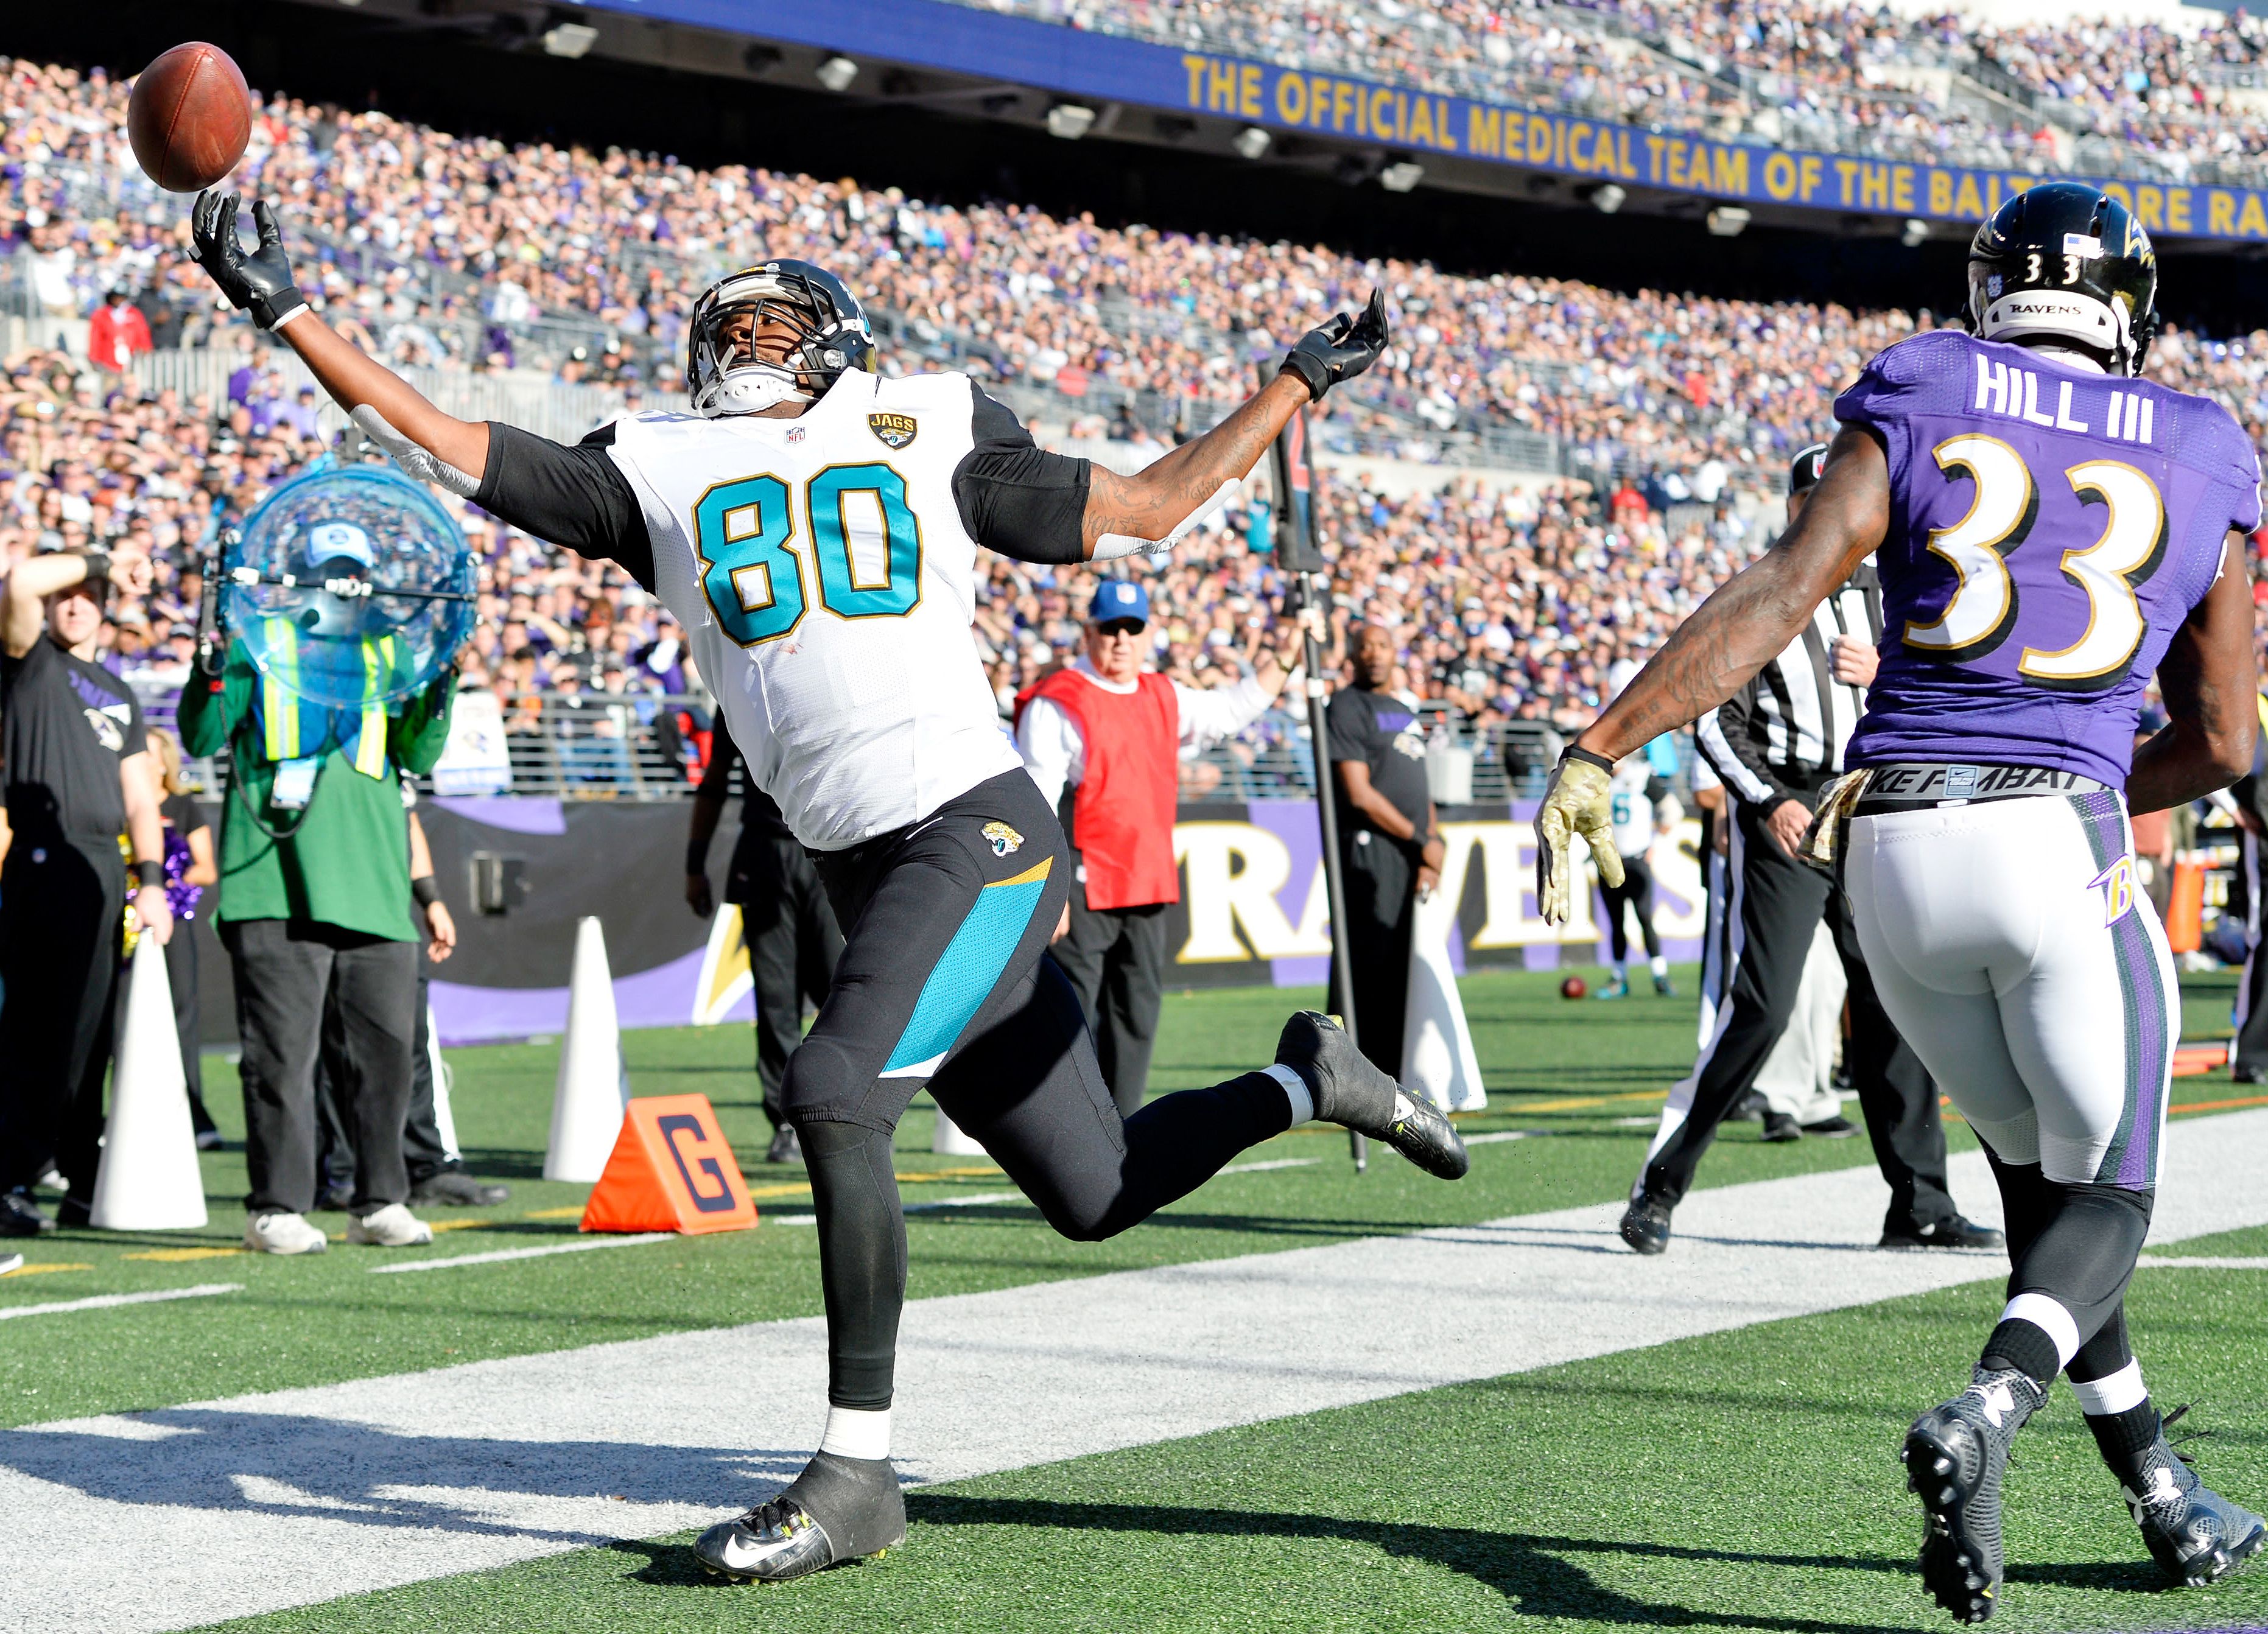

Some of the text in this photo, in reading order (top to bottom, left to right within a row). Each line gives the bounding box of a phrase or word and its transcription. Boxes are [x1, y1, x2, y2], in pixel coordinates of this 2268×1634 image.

[1182, 54, 1263, 117] THE
[1276, 71, 1456, 151] OFFICIAL
[1468, 105, 1637, 180] MEDICAL
[1646, 135, 1749, 197] TEAM
[1764, 153, 1824, 201] OF
[1834, 160, 1916, 212] THE
[2009, 304, 2082, 315] RAVENS
[788, 433, 804, 443] NFL
[871, 415, 914, 432] JAGS
[1974, 352, 2154, 444] HILL III
[690, 460, 924, 650] 80
[1901, 432, 2169, 693] 33
[657, 1113, 737, 1213] G
